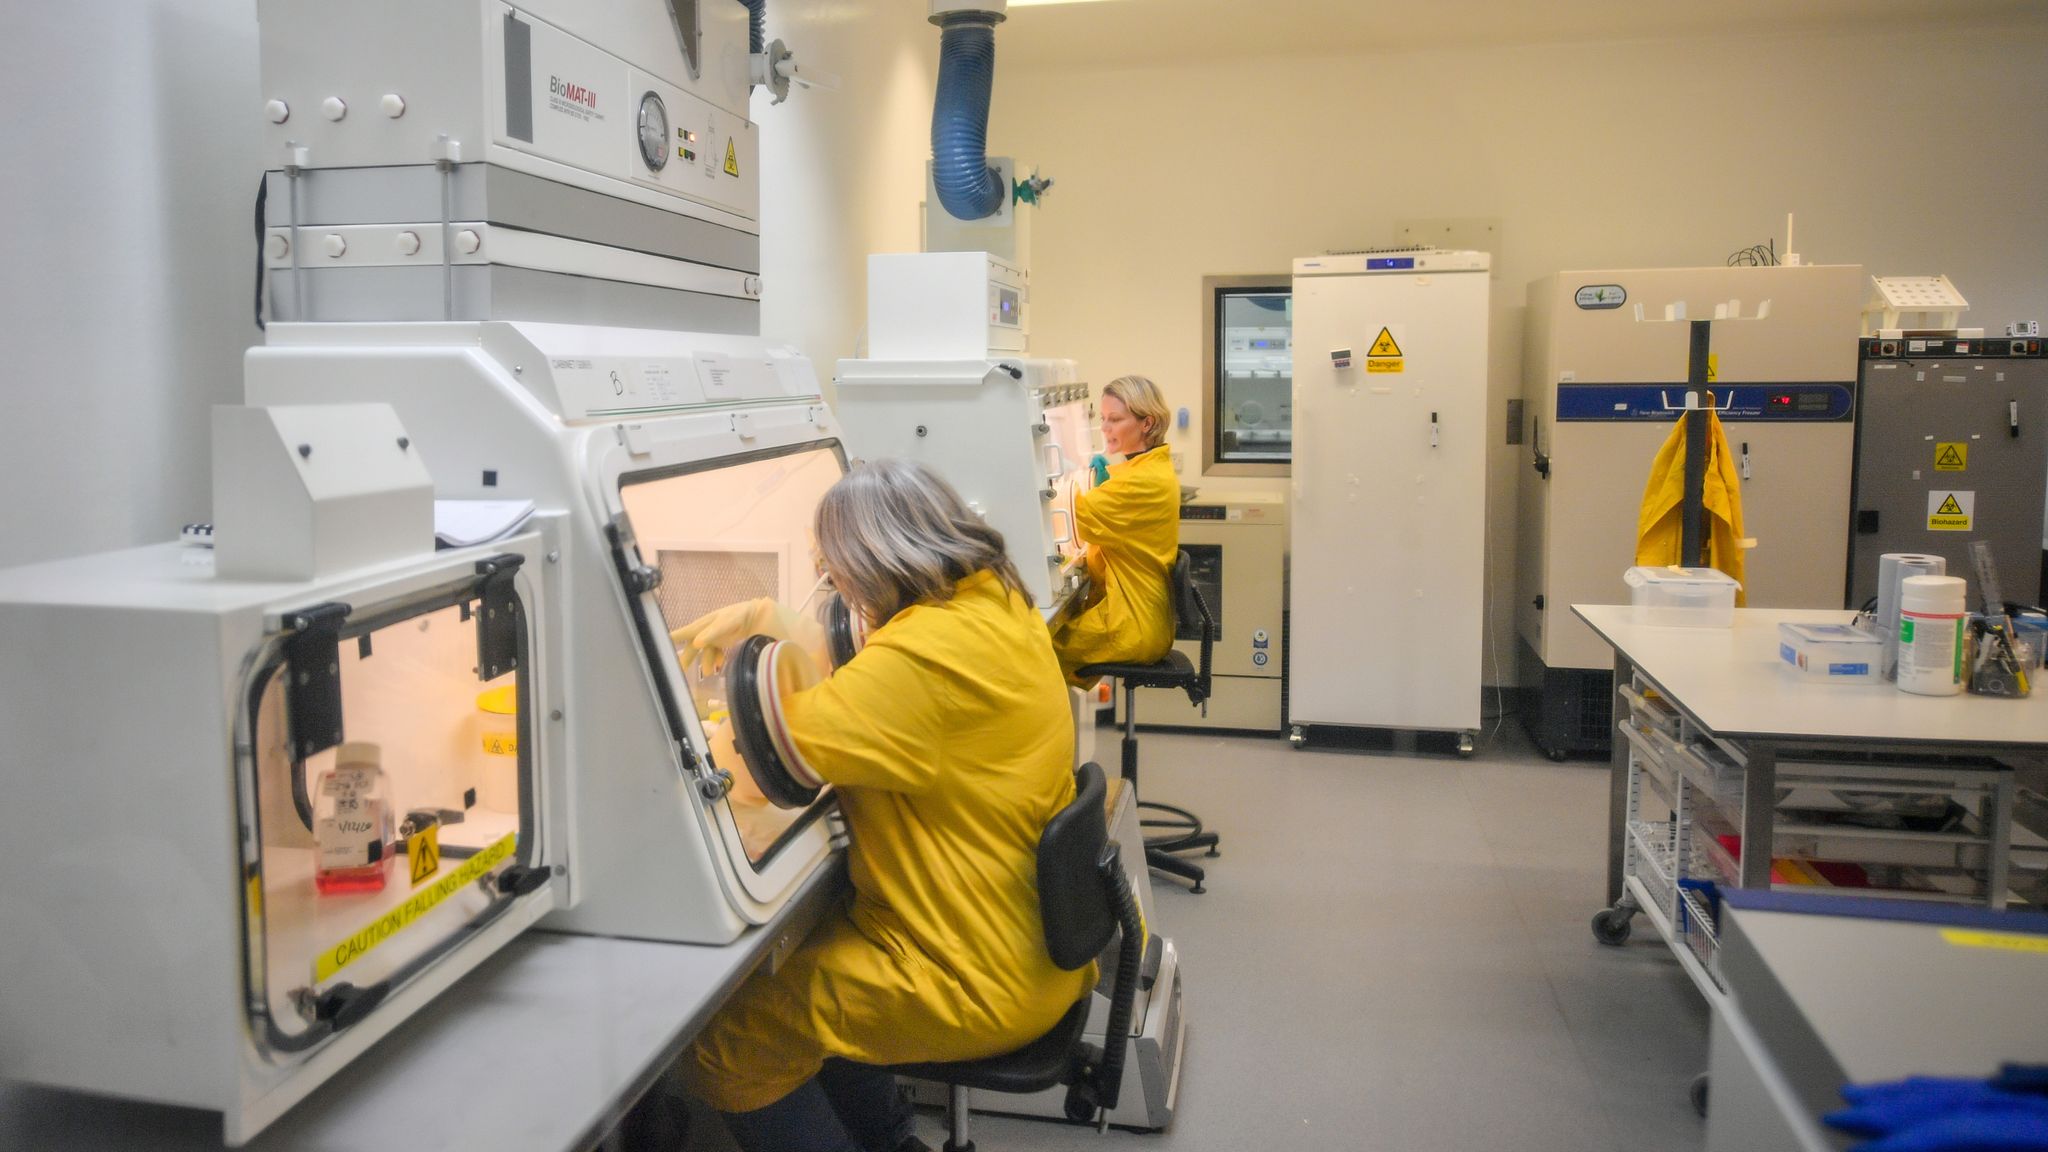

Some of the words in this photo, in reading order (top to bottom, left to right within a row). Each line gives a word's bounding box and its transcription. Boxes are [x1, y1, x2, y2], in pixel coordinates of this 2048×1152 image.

[1367, 360, 1401, 369] Danger
[1931, 518, 1968, 526] Biohazard
[335, 912, 401, 967] CAUTION
[404, 876, 458, 919] FALLING
[459, 842, 506, 881] HAZARD
